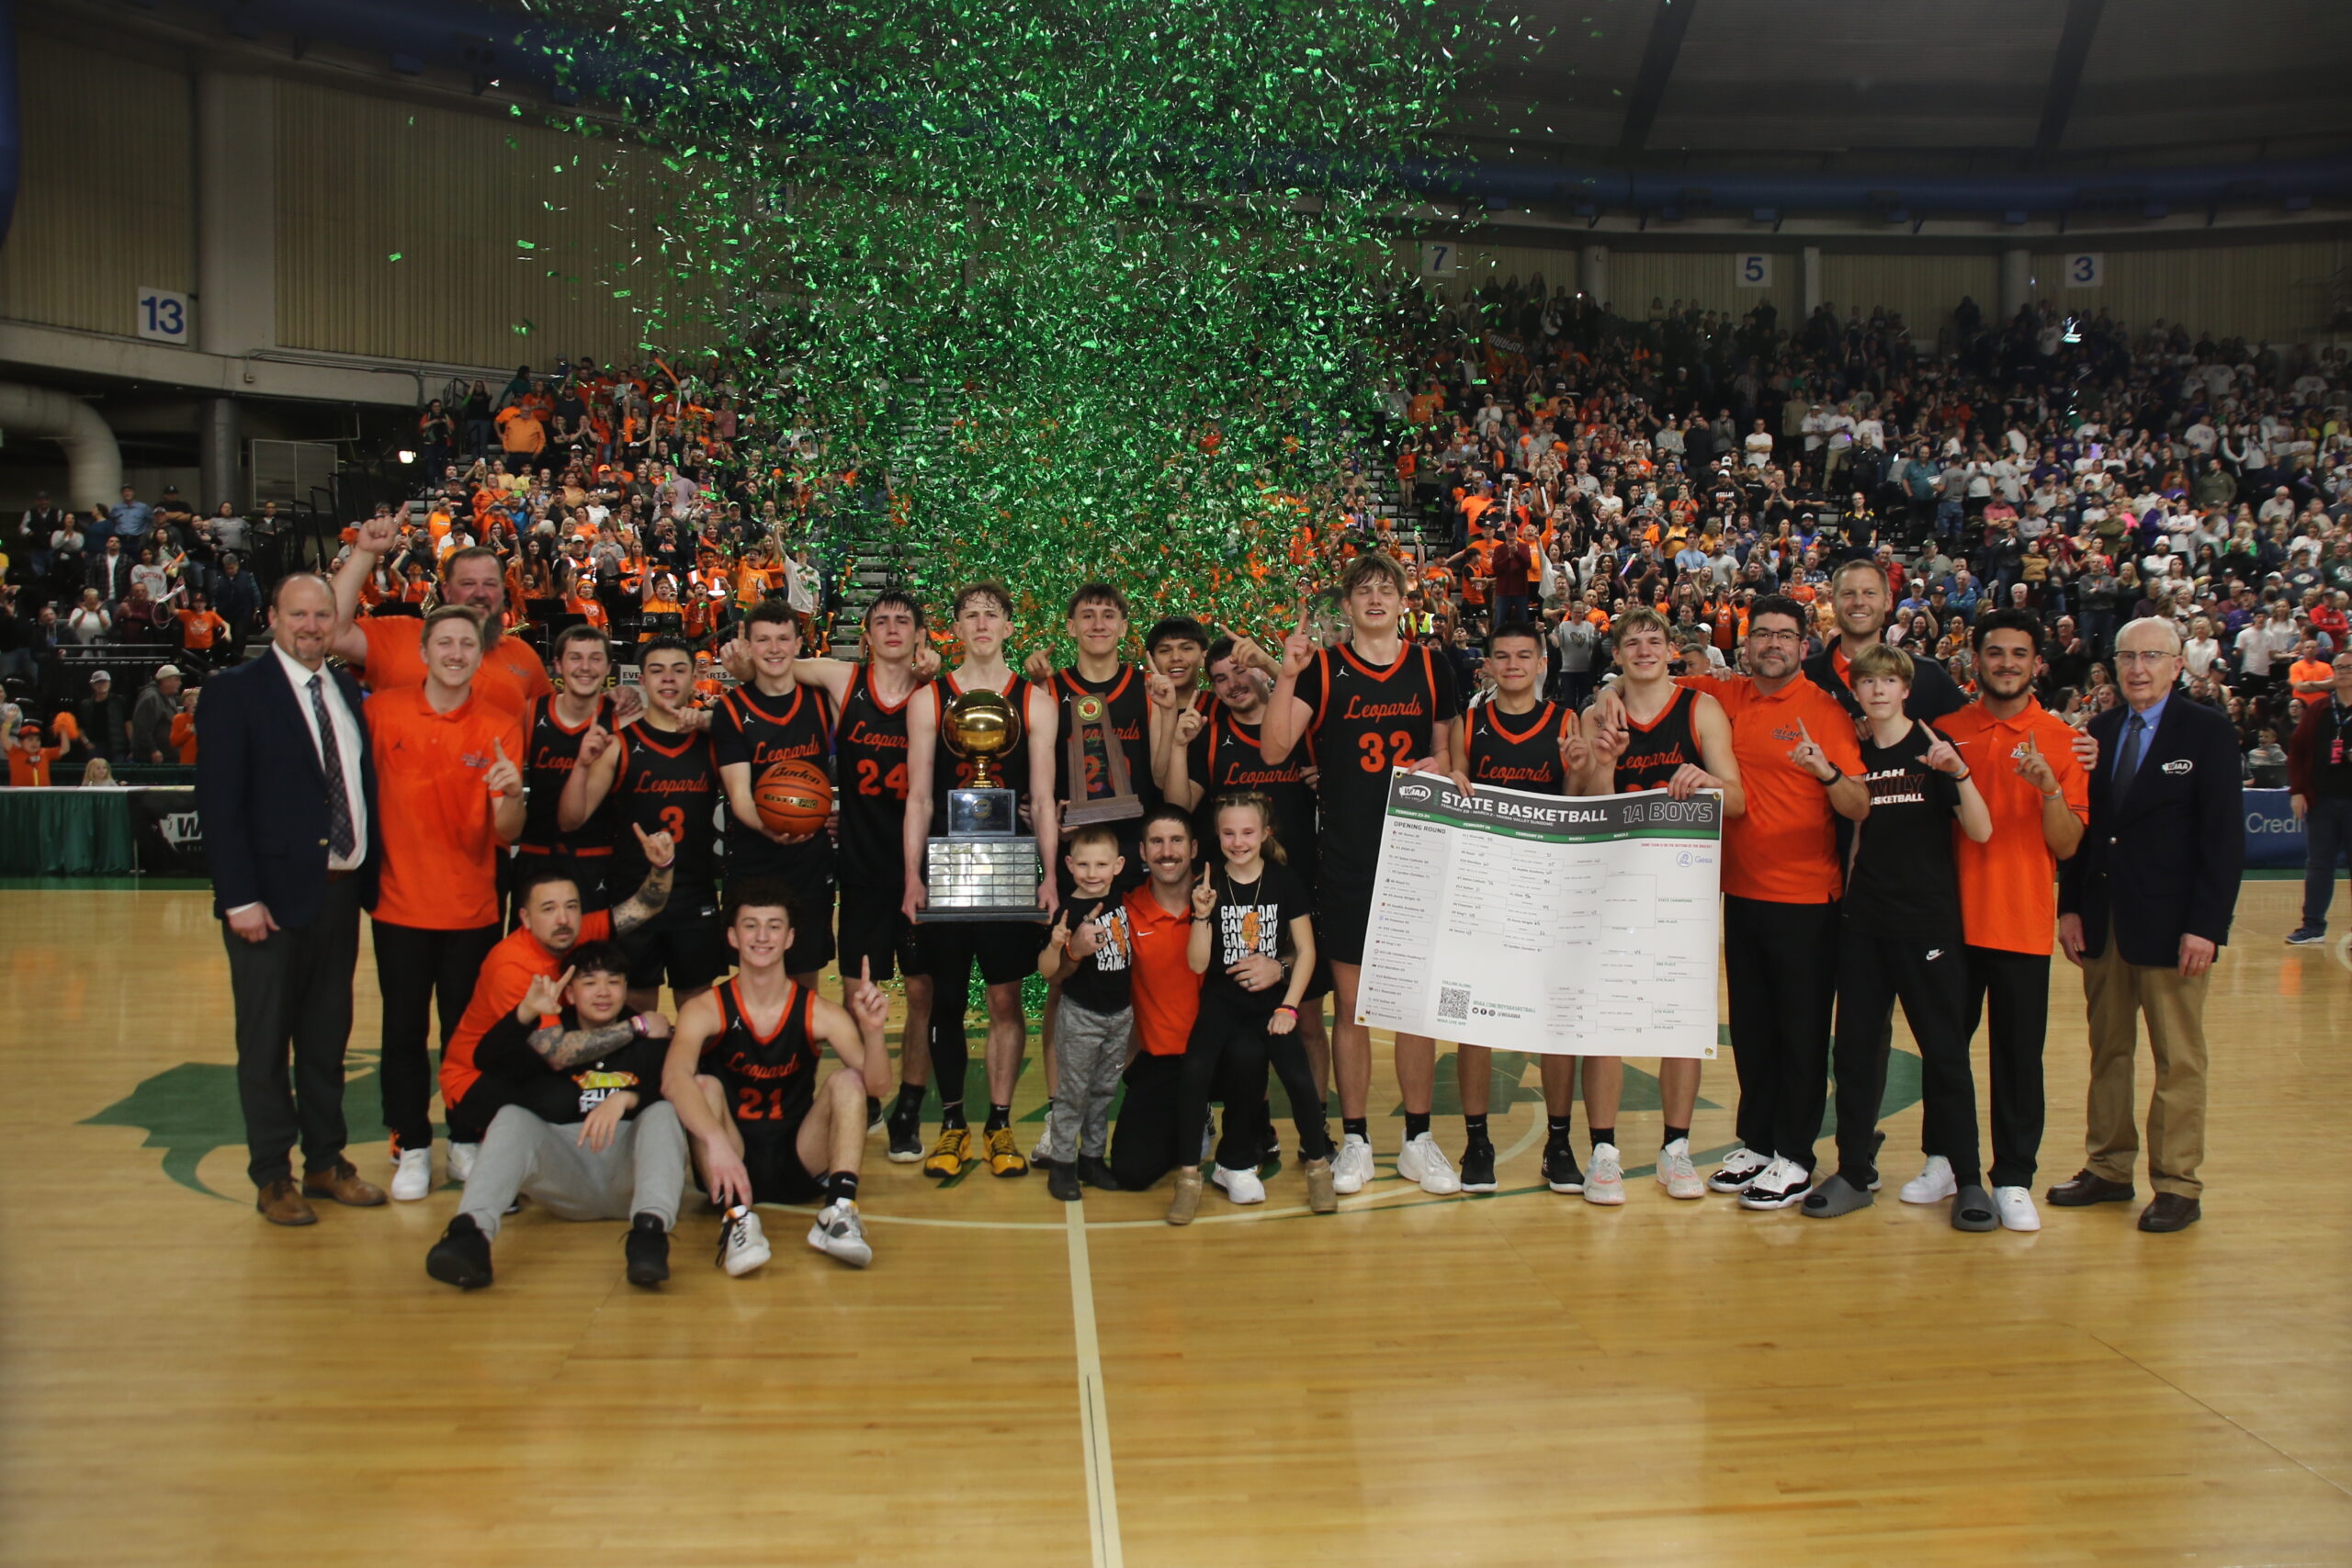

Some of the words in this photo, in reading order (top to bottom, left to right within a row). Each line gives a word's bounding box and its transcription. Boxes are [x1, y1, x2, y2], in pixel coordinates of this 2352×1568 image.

[1431, 245, 1449, 272] 7
[1745, 256, 1765, 282] 5
[2074, 256, 2095, 282] 3
[141, 295, 185, 335] 13
[1343, 694, 1423, 723] Leopards
[752, 733, 820, 764] Leopards
[847, 720, 910, 752] Leopar
[1358, 730, 1416, 773] 32
[856, 759, 909, 799] 24
[1223, 761, 1302, 790] Leopards
[1476, 754, 1553, 785] Leopards
[1864, 768, 1905, 782] LLAH
[633, 770, 710, 797] Leopards
[1404, 786, 1427, 797] WIAA
[1395, 809, 1418, 818] FEBRUARY
[1441, 791, 1495, 811] STATE
[1498, 802, 1608, 824] BASKETBALL
[1441, 803, 1463, 813] FEBRUARY
[1623, 804, 1645, 824] 1A
[1648, 801, 1713, 823] BOYS
[1871, 794, 1926, 807] SKETBALL
[660, 806, 684, 843] 3
[1394, 821, 1422, 830] OPENING
[2245, 812, 2302, 833] Credi
[1258, 904, 1278, 921] DAY
[1221, 919, 1243, 934] GAM
[1259, 919, 1278, 938] DAY
[1223, 933, 1246, 949] GAM
[1259, 934, 1278, 952] DAY
[725, 1051, 800, 1081] Leopards
[738, 1088, 785, 1120] 21
